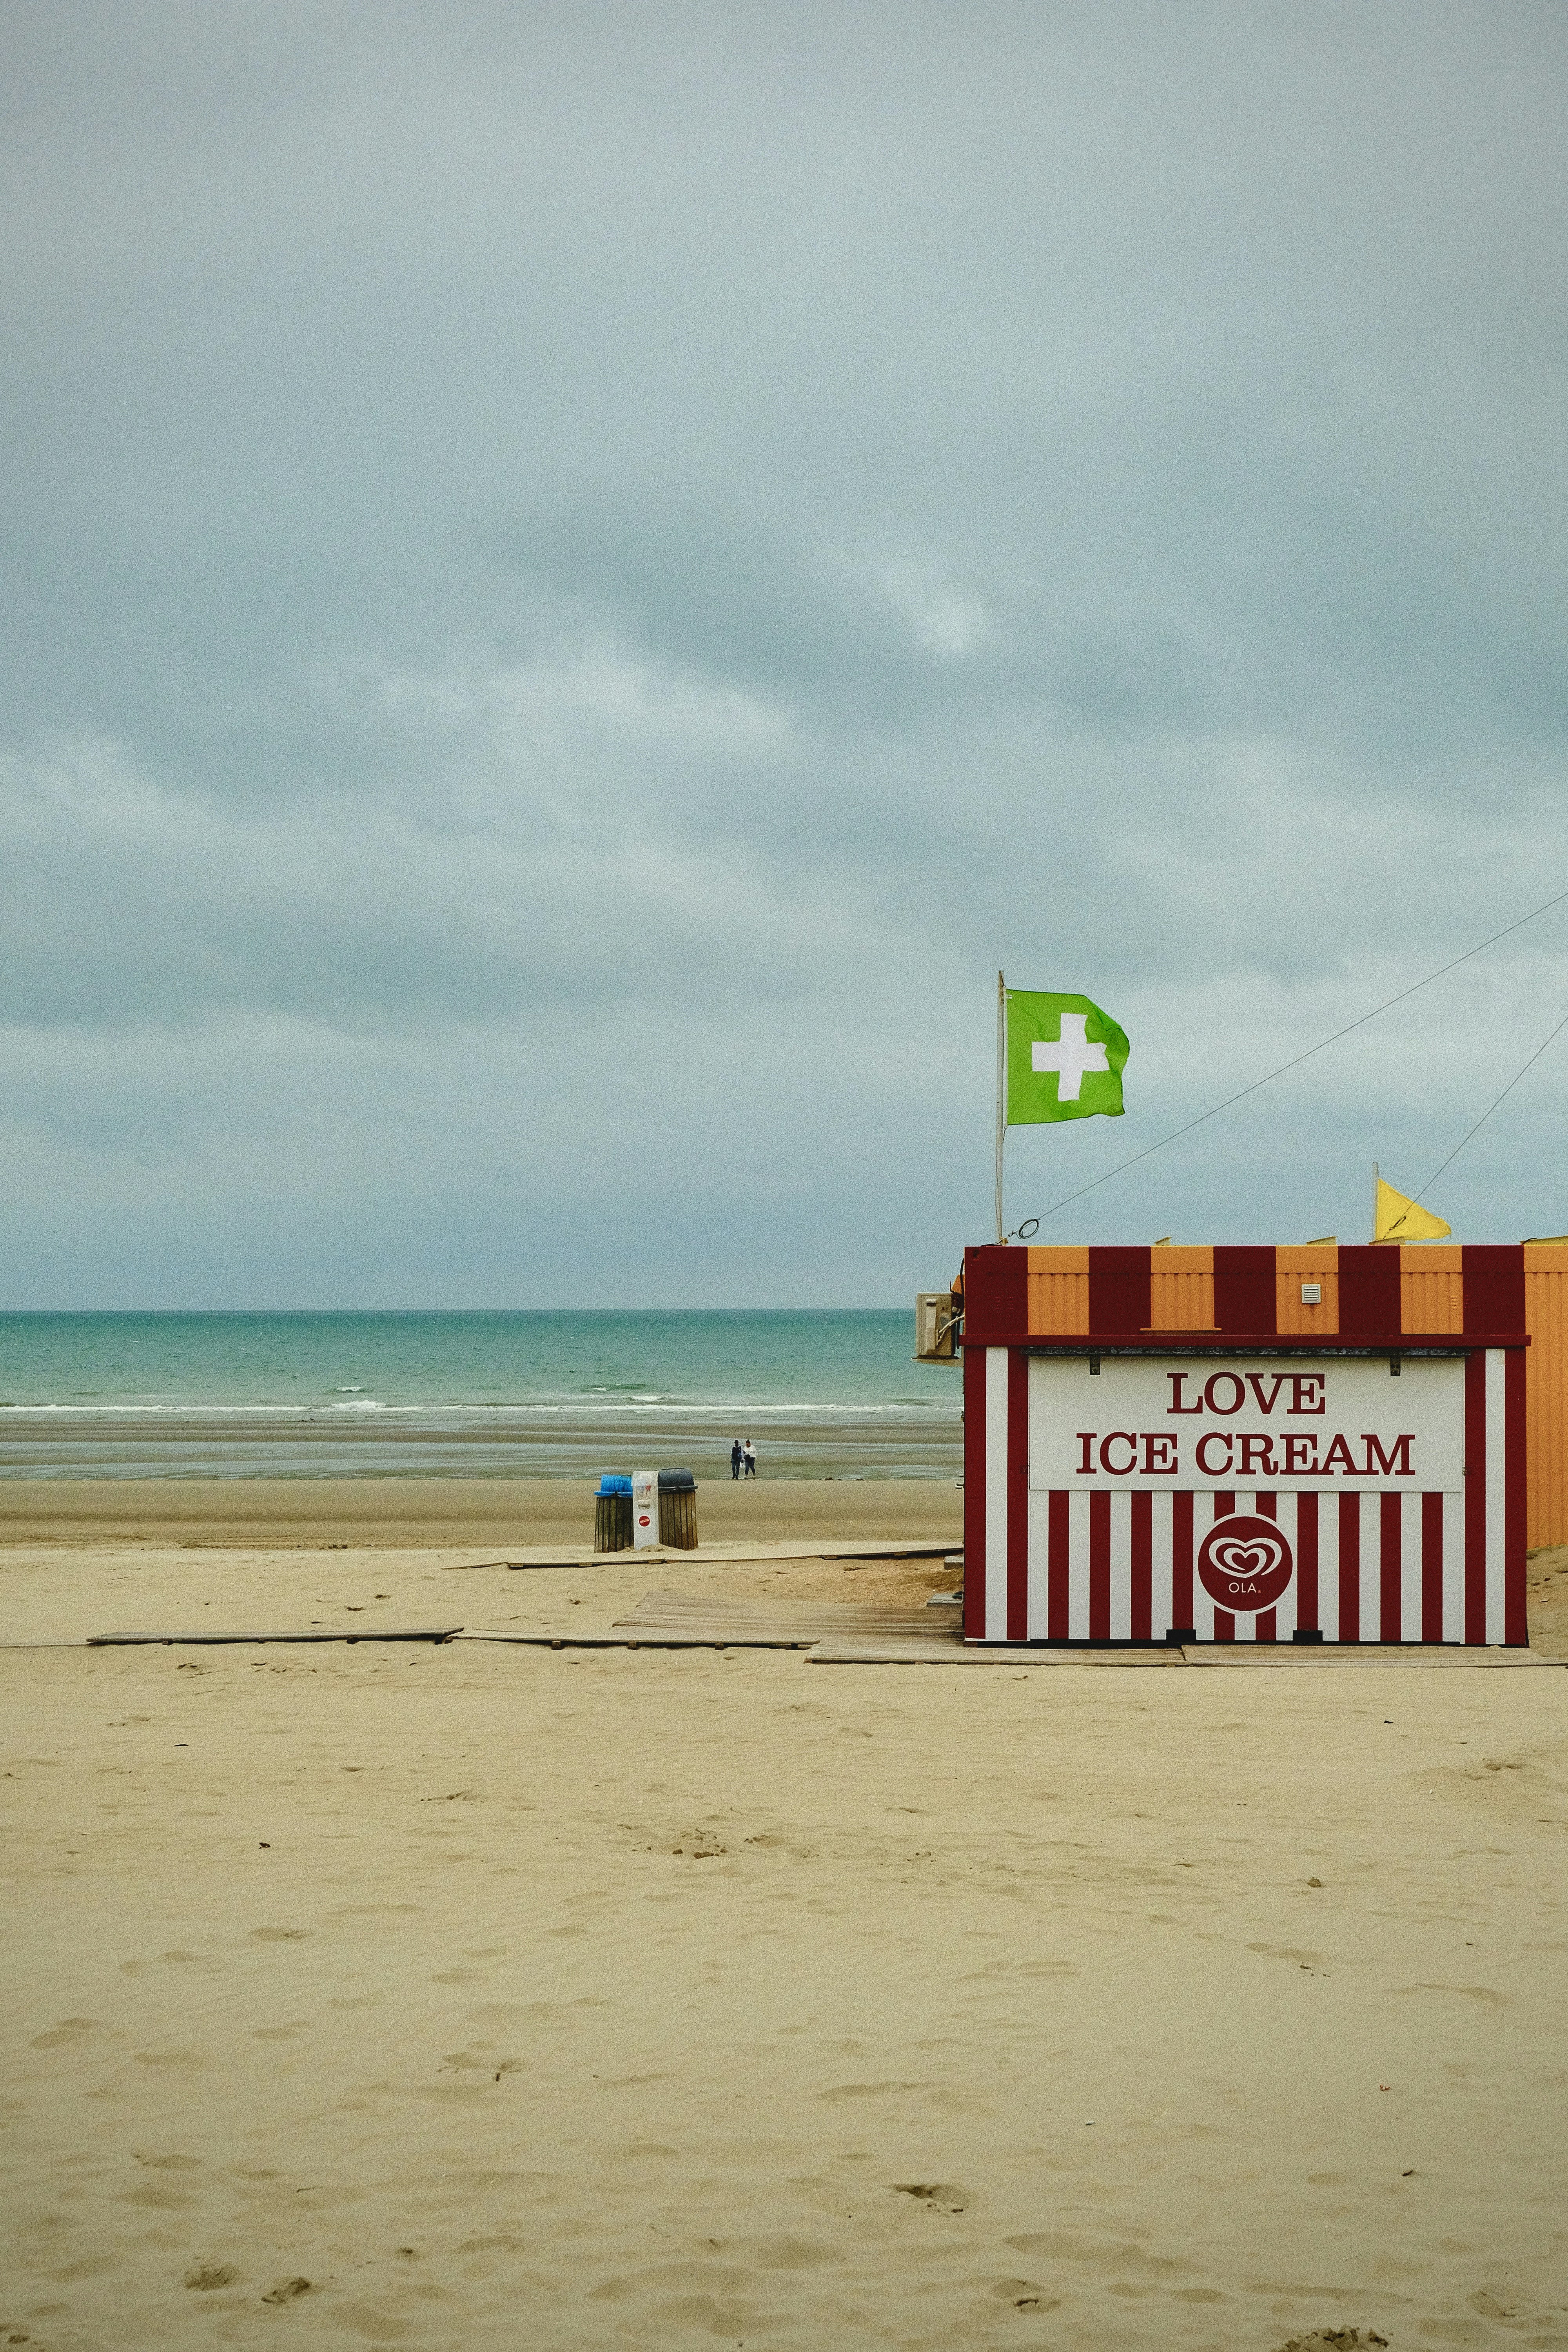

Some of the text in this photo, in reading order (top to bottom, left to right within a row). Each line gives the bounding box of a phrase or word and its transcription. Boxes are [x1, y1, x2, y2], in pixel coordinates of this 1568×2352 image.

[1167, 1372, 1326, 1415] LOVE
[1076, 1432, 1416, 1476] ICE CREAM
[1229, 1582, 1257, 1593] OLA
